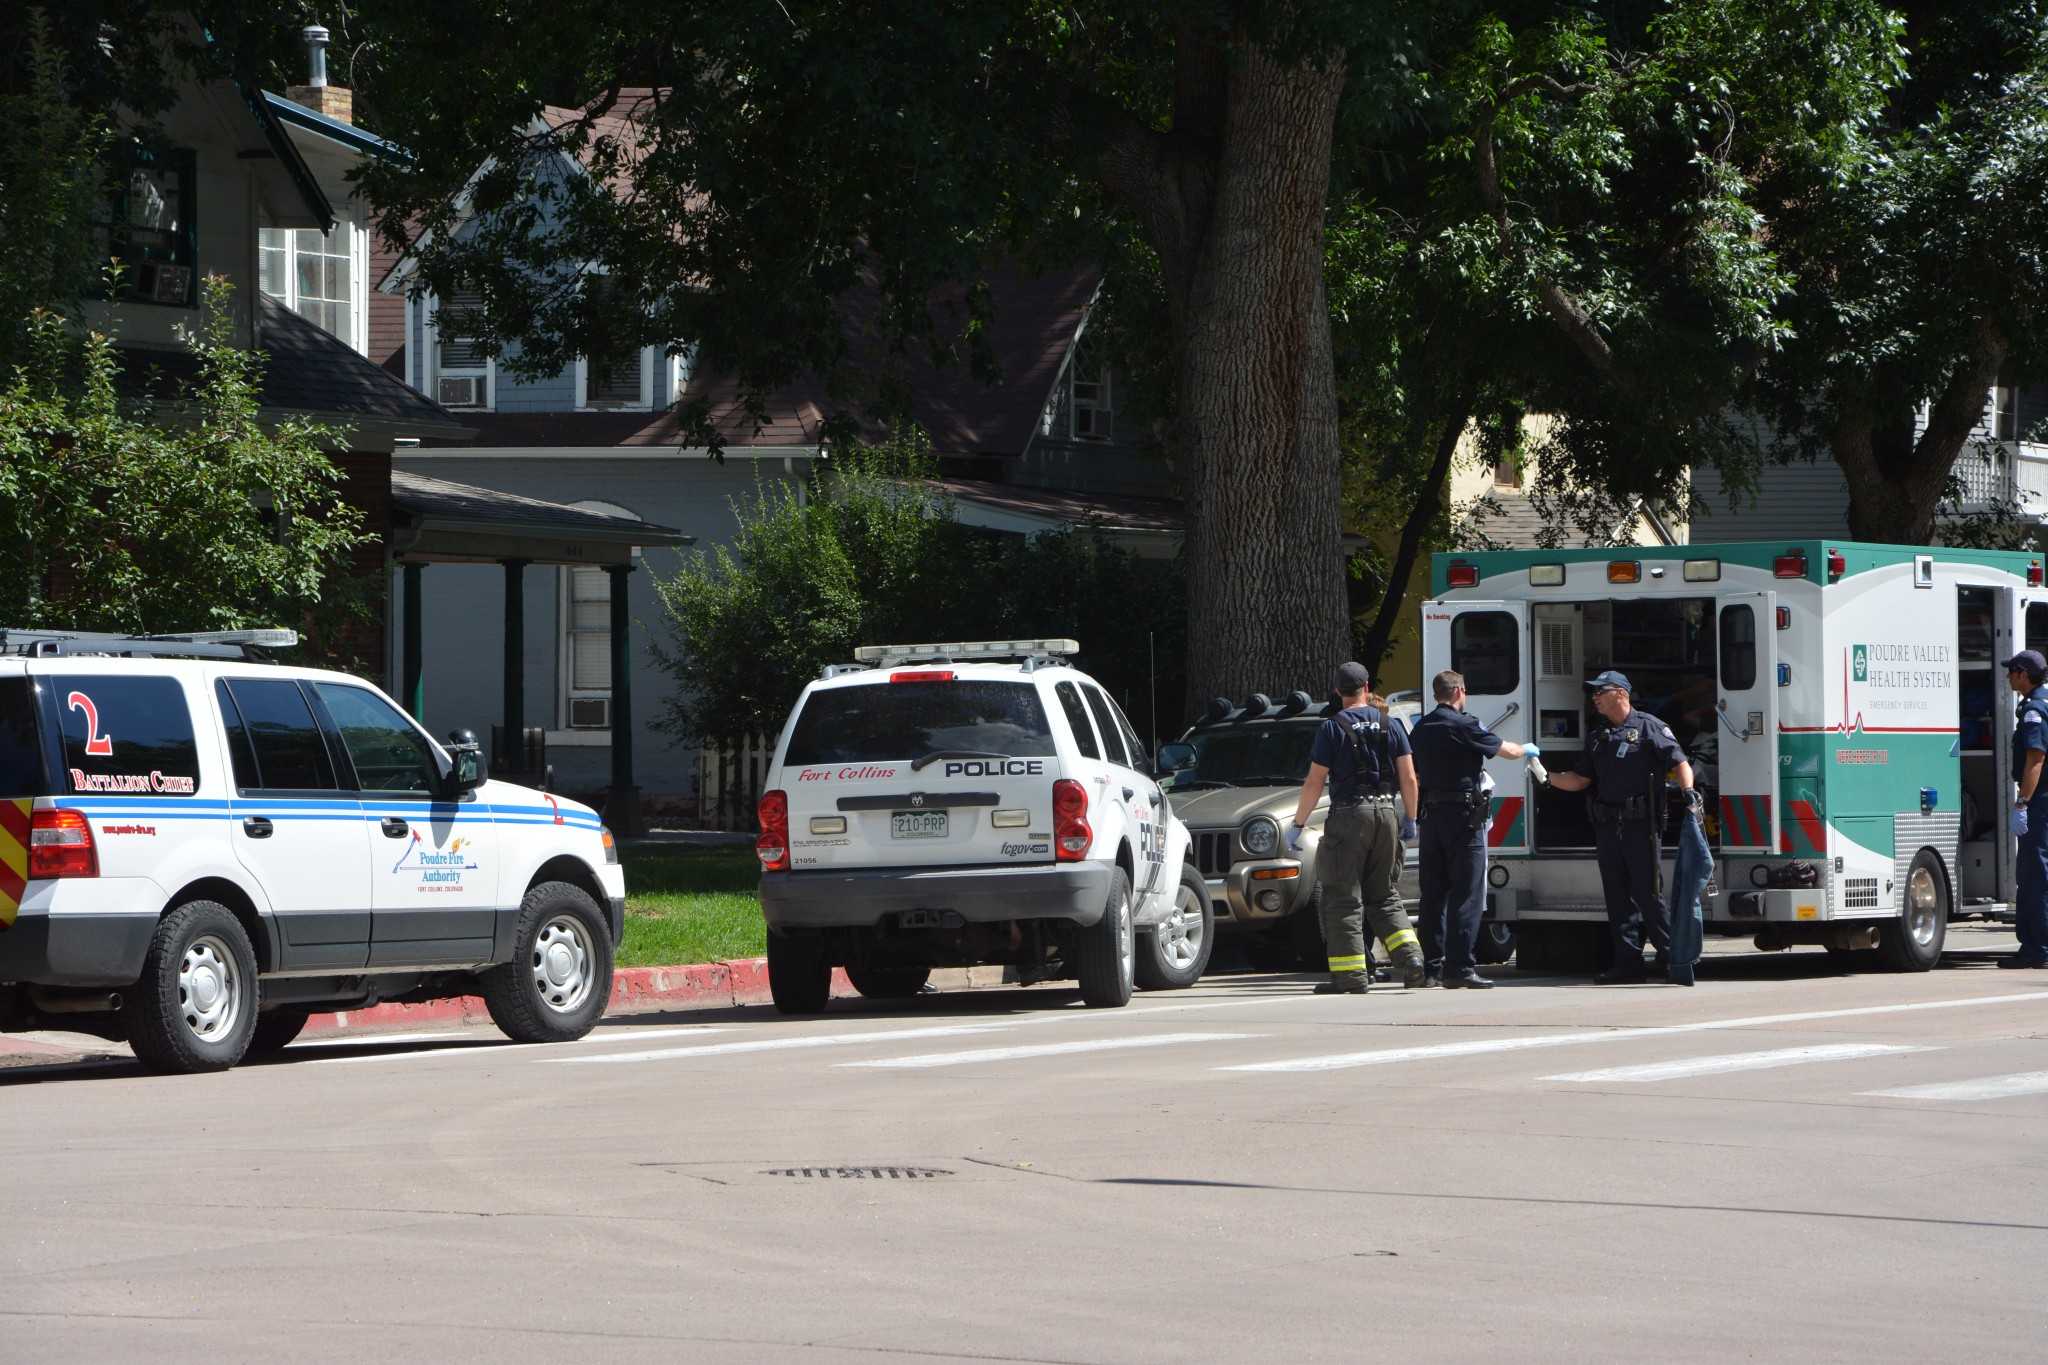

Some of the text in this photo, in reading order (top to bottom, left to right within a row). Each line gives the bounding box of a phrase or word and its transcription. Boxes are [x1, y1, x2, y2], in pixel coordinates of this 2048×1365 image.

[1869, 644, 1951, 662] POUDRE VALLEY
[1869, 670, 1951, 688] HEALTH SYSTEM
[68, 691, 113, 756] 2
[798, 766, 896, 781] Fort Collins
[945, 761, 1044, 777] POLICE
[70, 768, 151, 792] BATTALION
[543, 793, 564, 825] 2
[899, 815, 946, 832] 210-PRP
[420, 851, 464, 865] Poudre Fire
[422, 869, 461, 884] Authority
